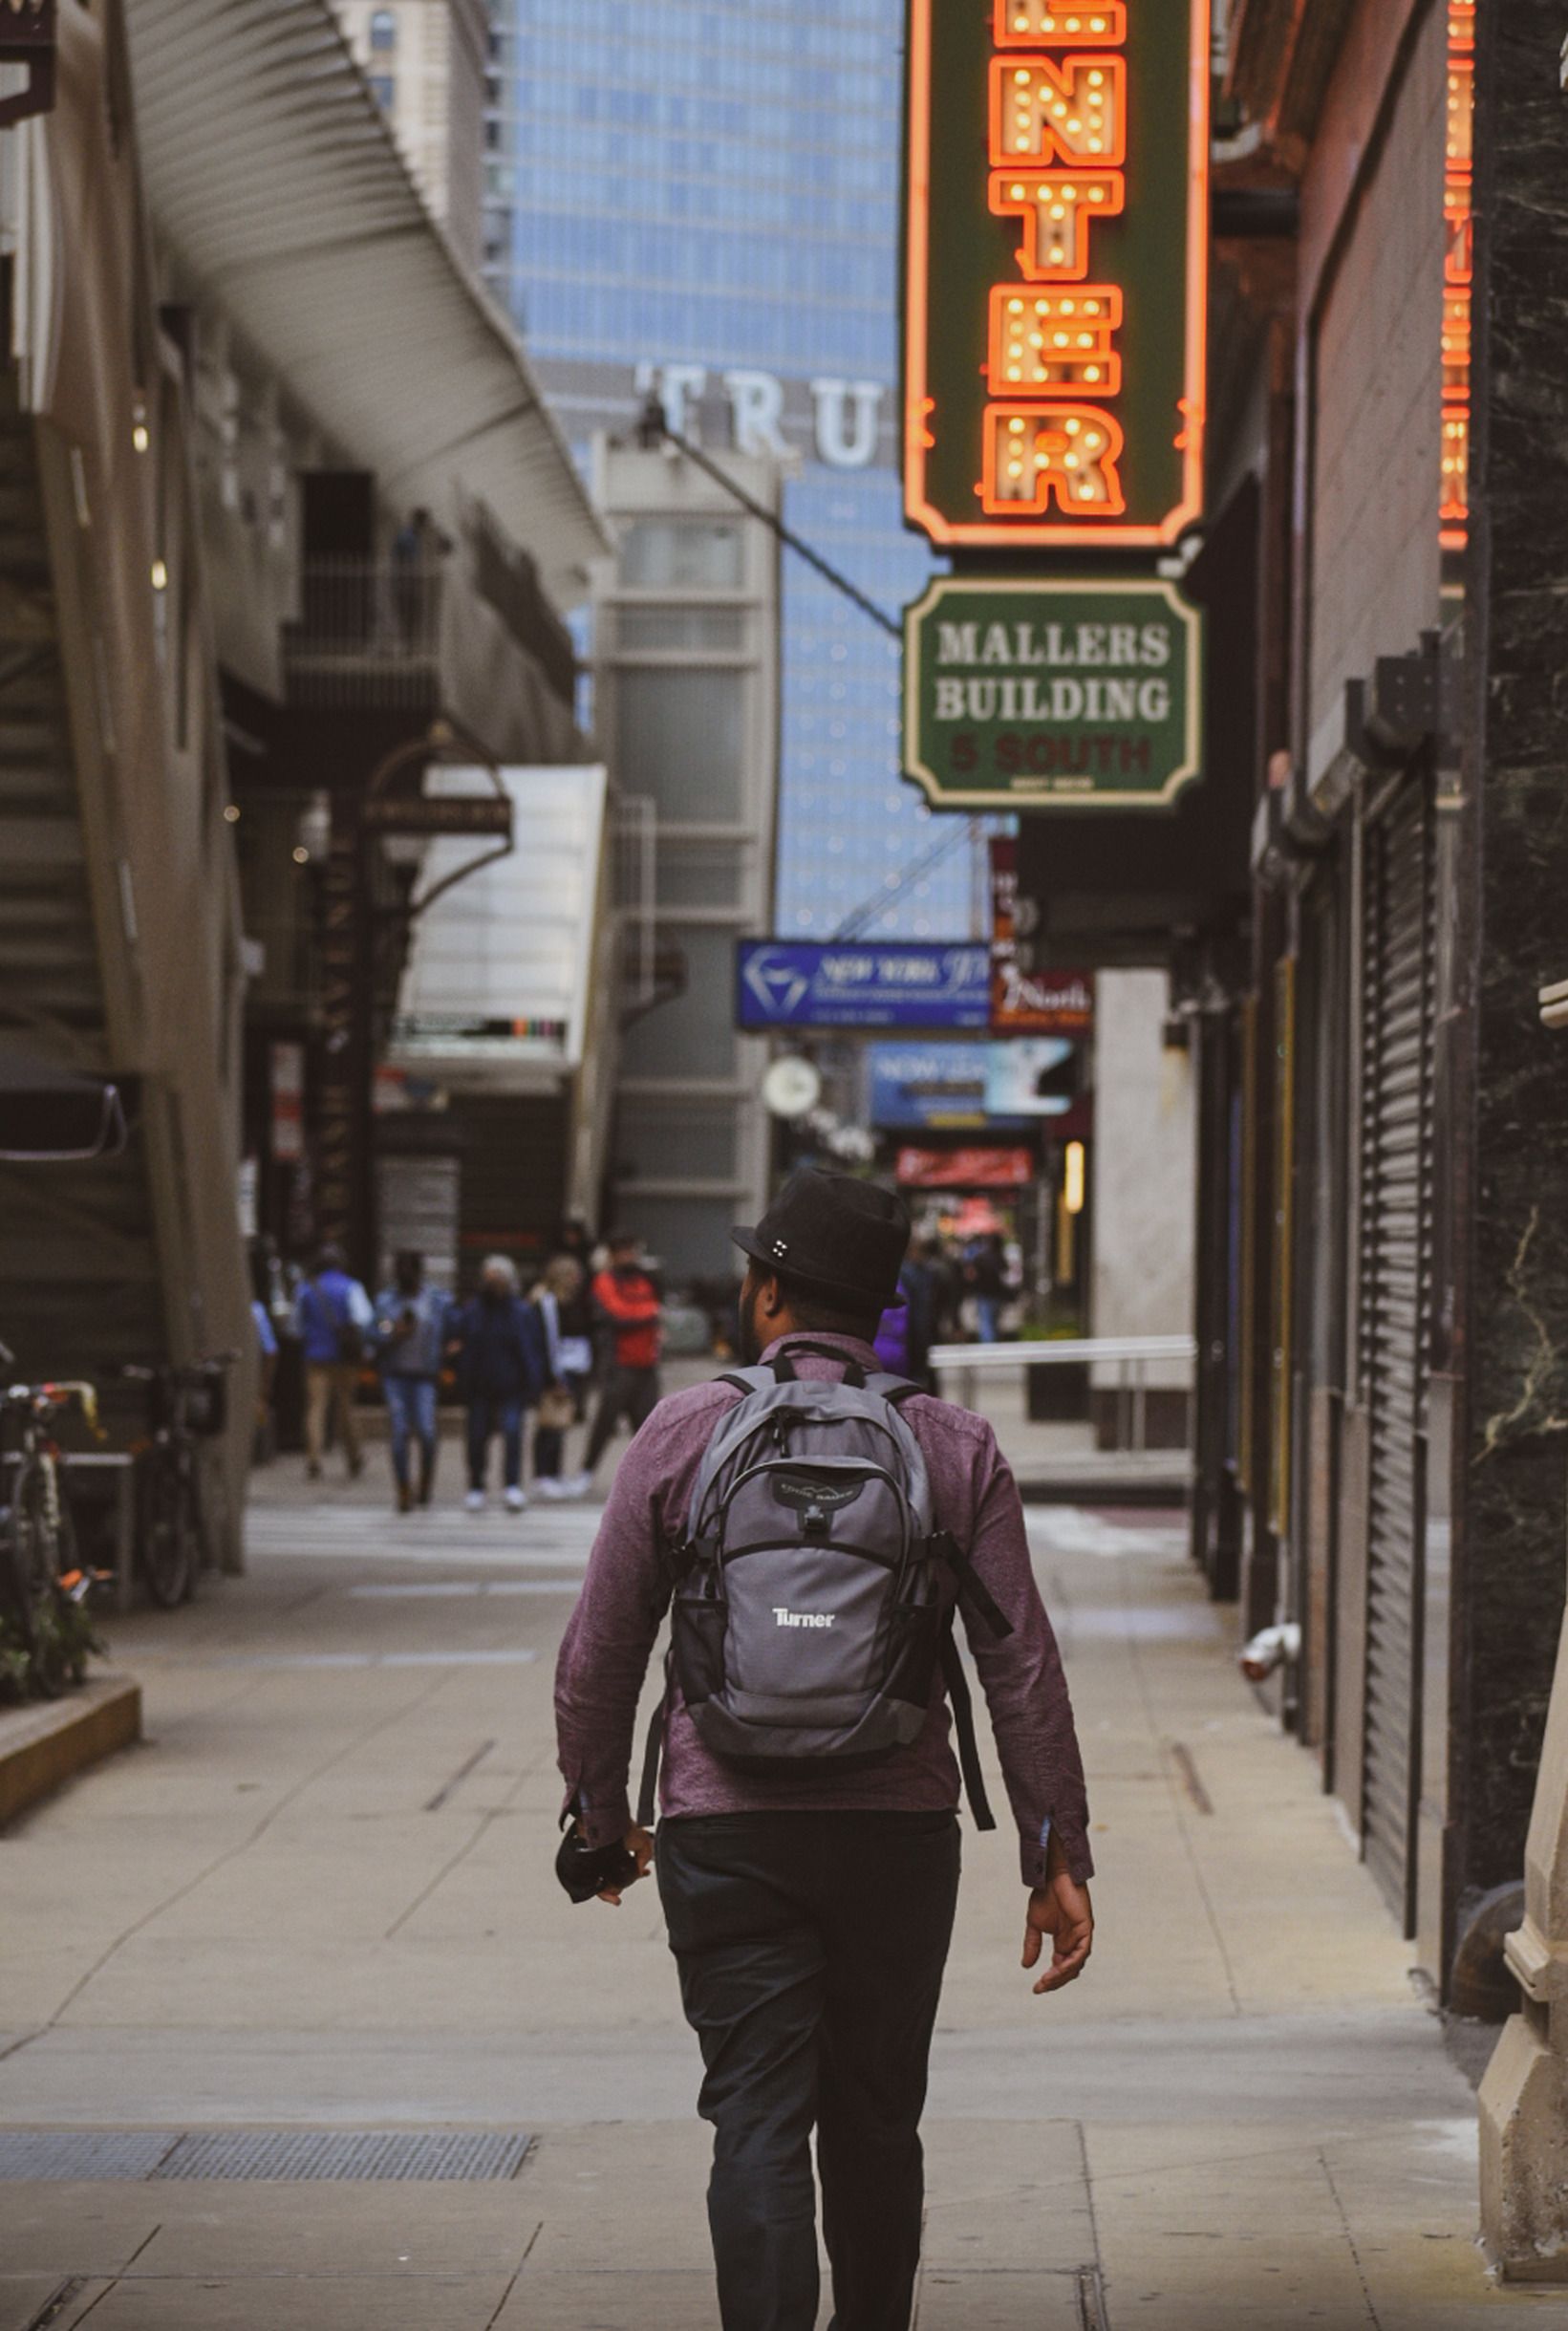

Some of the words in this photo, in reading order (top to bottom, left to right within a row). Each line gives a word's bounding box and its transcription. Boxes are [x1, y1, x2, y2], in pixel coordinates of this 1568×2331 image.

[936, 622, 1170, 666] MALLERS
[935, 677, 1170, 722] BUILDING
[950, 733, 978, 771] 5
[996, 733, 1152, 771] SOUTH
[772, 1608, 835, 1628] Turner
